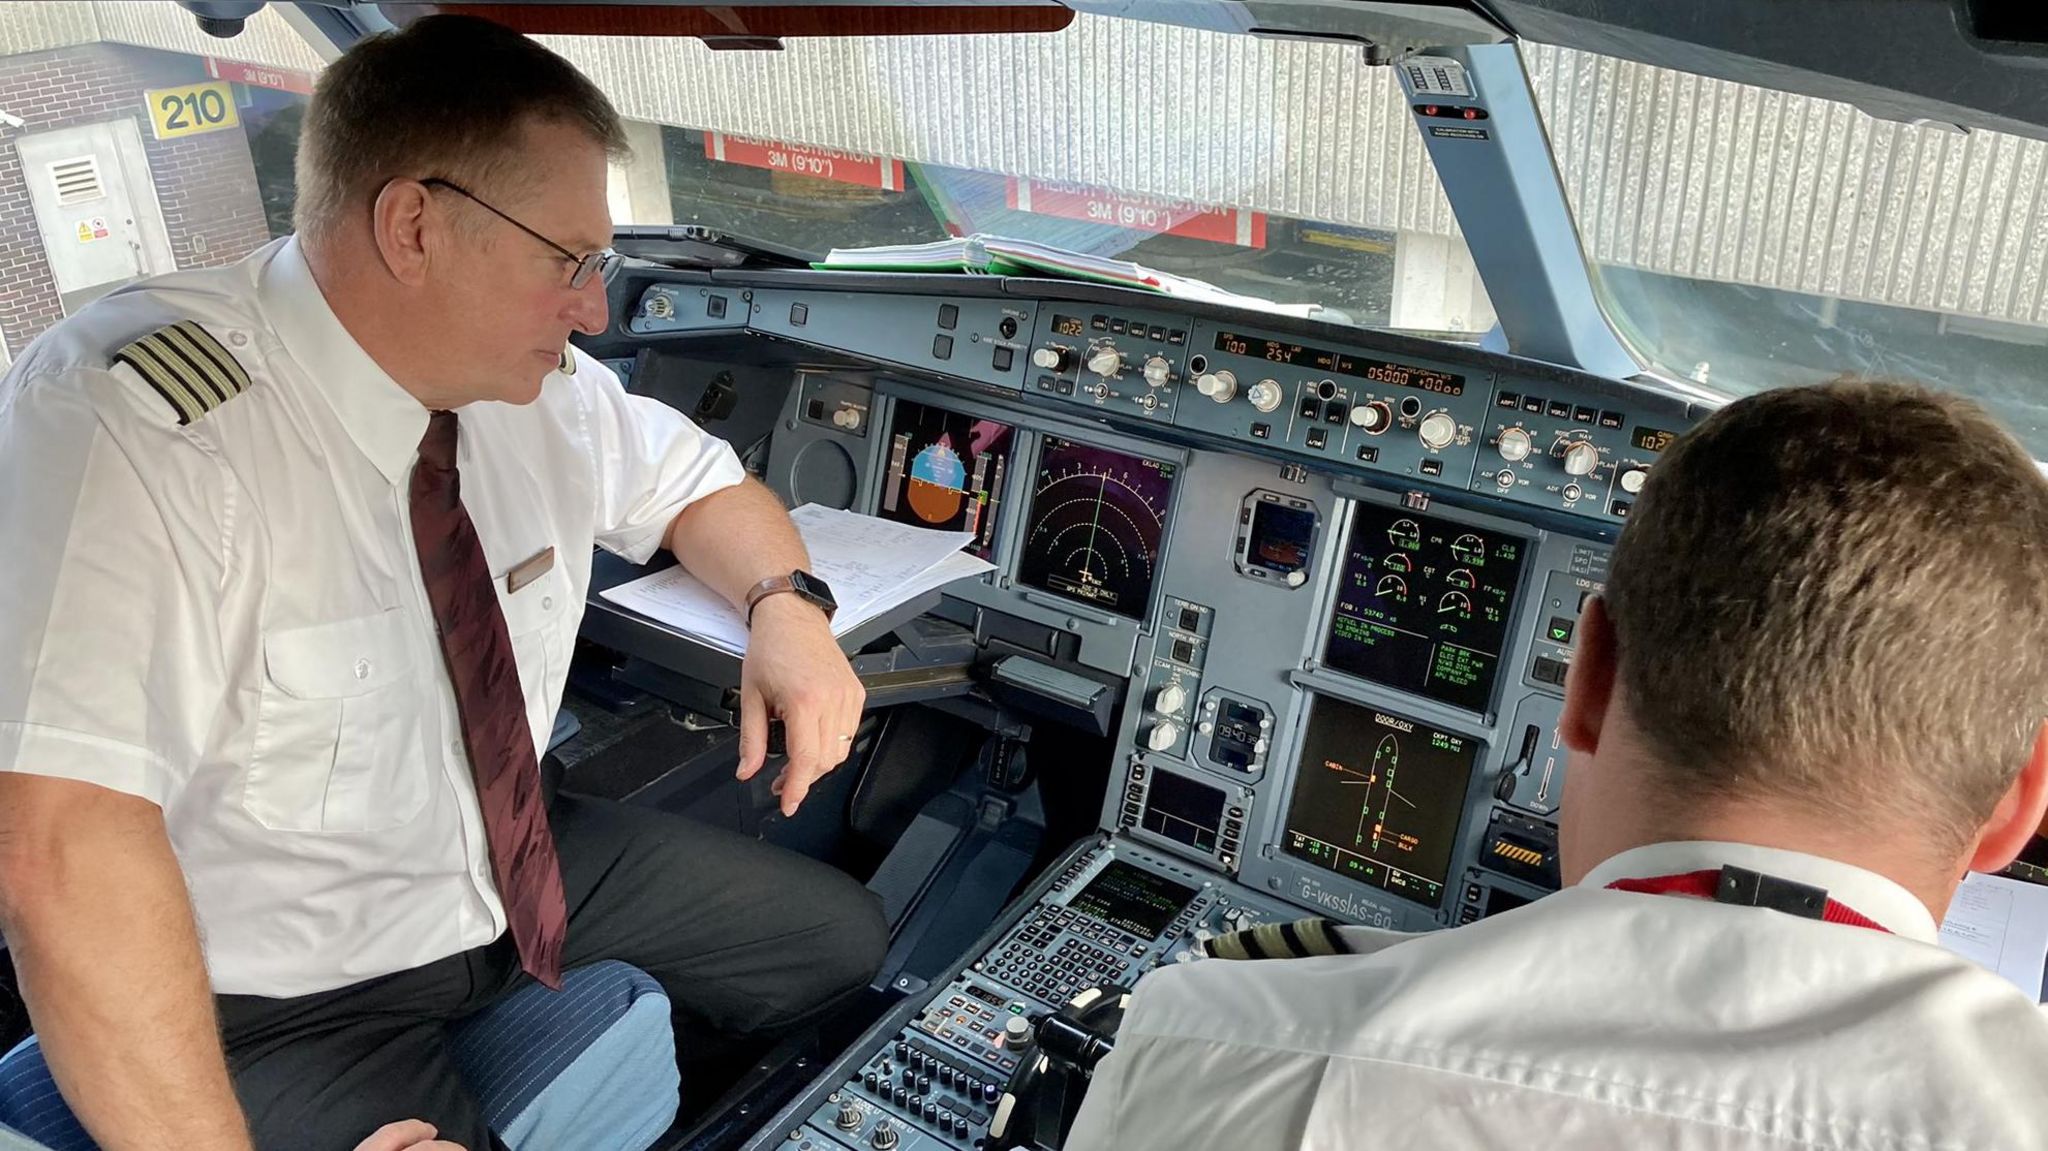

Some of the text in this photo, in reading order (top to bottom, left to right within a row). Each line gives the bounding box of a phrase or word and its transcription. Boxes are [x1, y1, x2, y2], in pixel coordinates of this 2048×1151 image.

[161, 90, 225, 130] 210
[768, 151, 788, 168] 3M
[1087, 201, 1112, 220] 3M
[1058, 322, 1083, 337] 1022
[1225, 341, 1292, 362] 100 254
[1367, 367, 1408, 385] 05000
[1500, 399, 1514, 407] ARPT
[1602, 418, 1618, 427] CSTR
[1575, 578, 1590, 588] LDG
[1375, 713, 1414, 732] DOOR/OXY
[1433, 732, 1448, 740] CKPT
[1400, 833, 1419, 845] CARGO
[1302, 885, 1347, 913] G-VKSS
